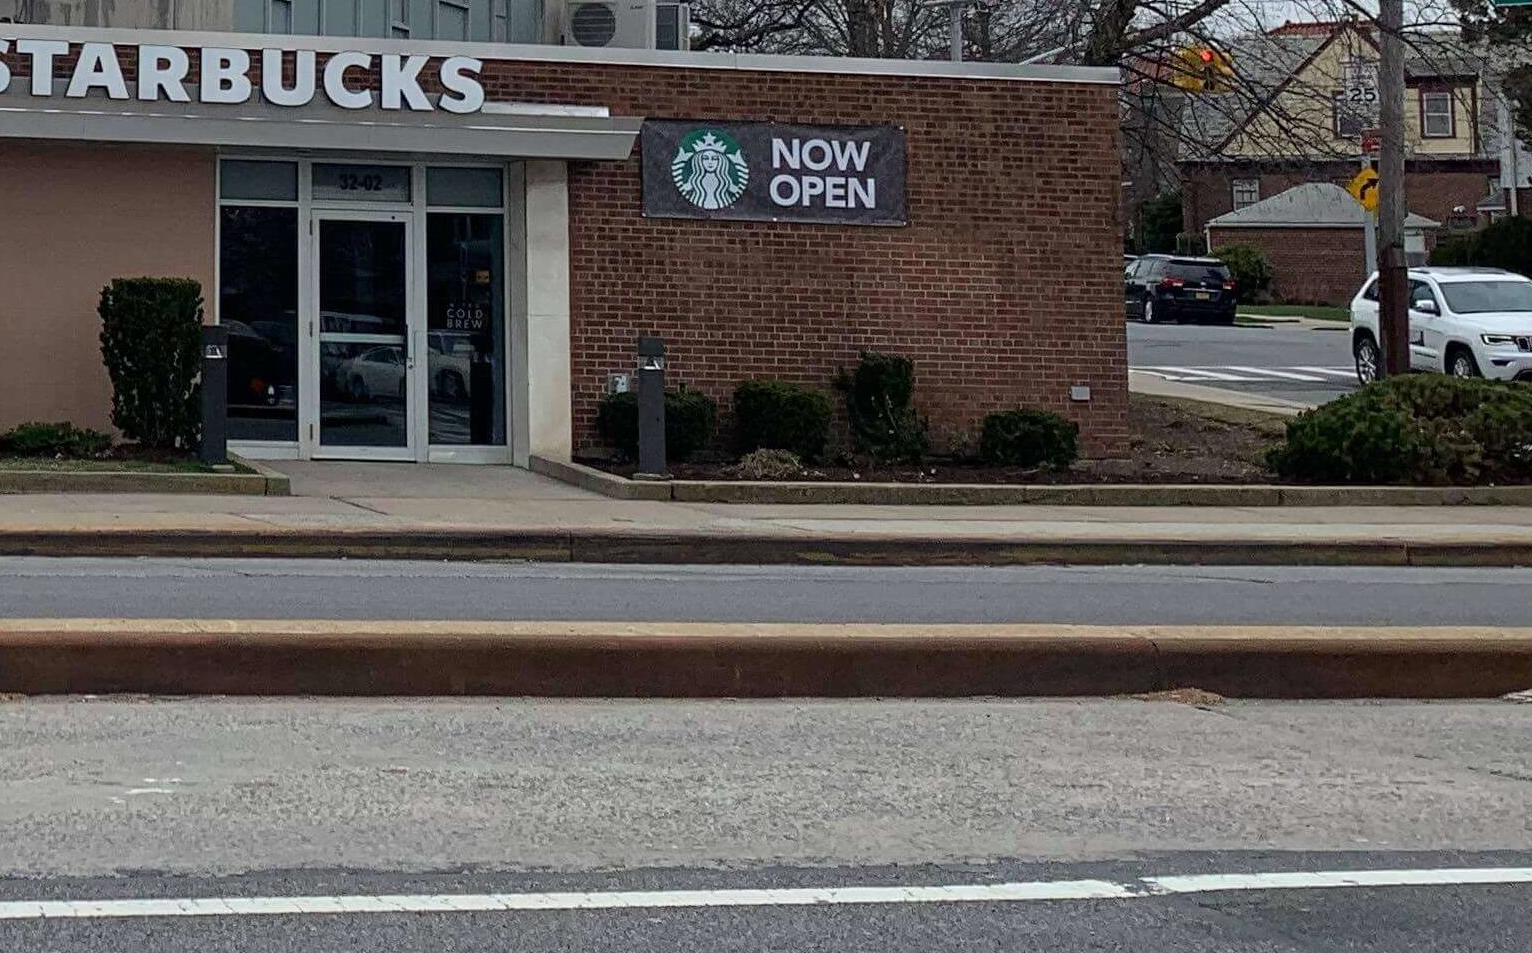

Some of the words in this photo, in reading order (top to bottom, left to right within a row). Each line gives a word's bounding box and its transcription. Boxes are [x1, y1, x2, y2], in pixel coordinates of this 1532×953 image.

[1349, 87, 1376, 102] 25
[771, 137, 871, 172] NOW
[339, 173, 382, 191] 32-02
[769, 174, 876, 209] OPEN
[446, 308, 483, 319] COLD
[446, 318, 483, 329] BREW
